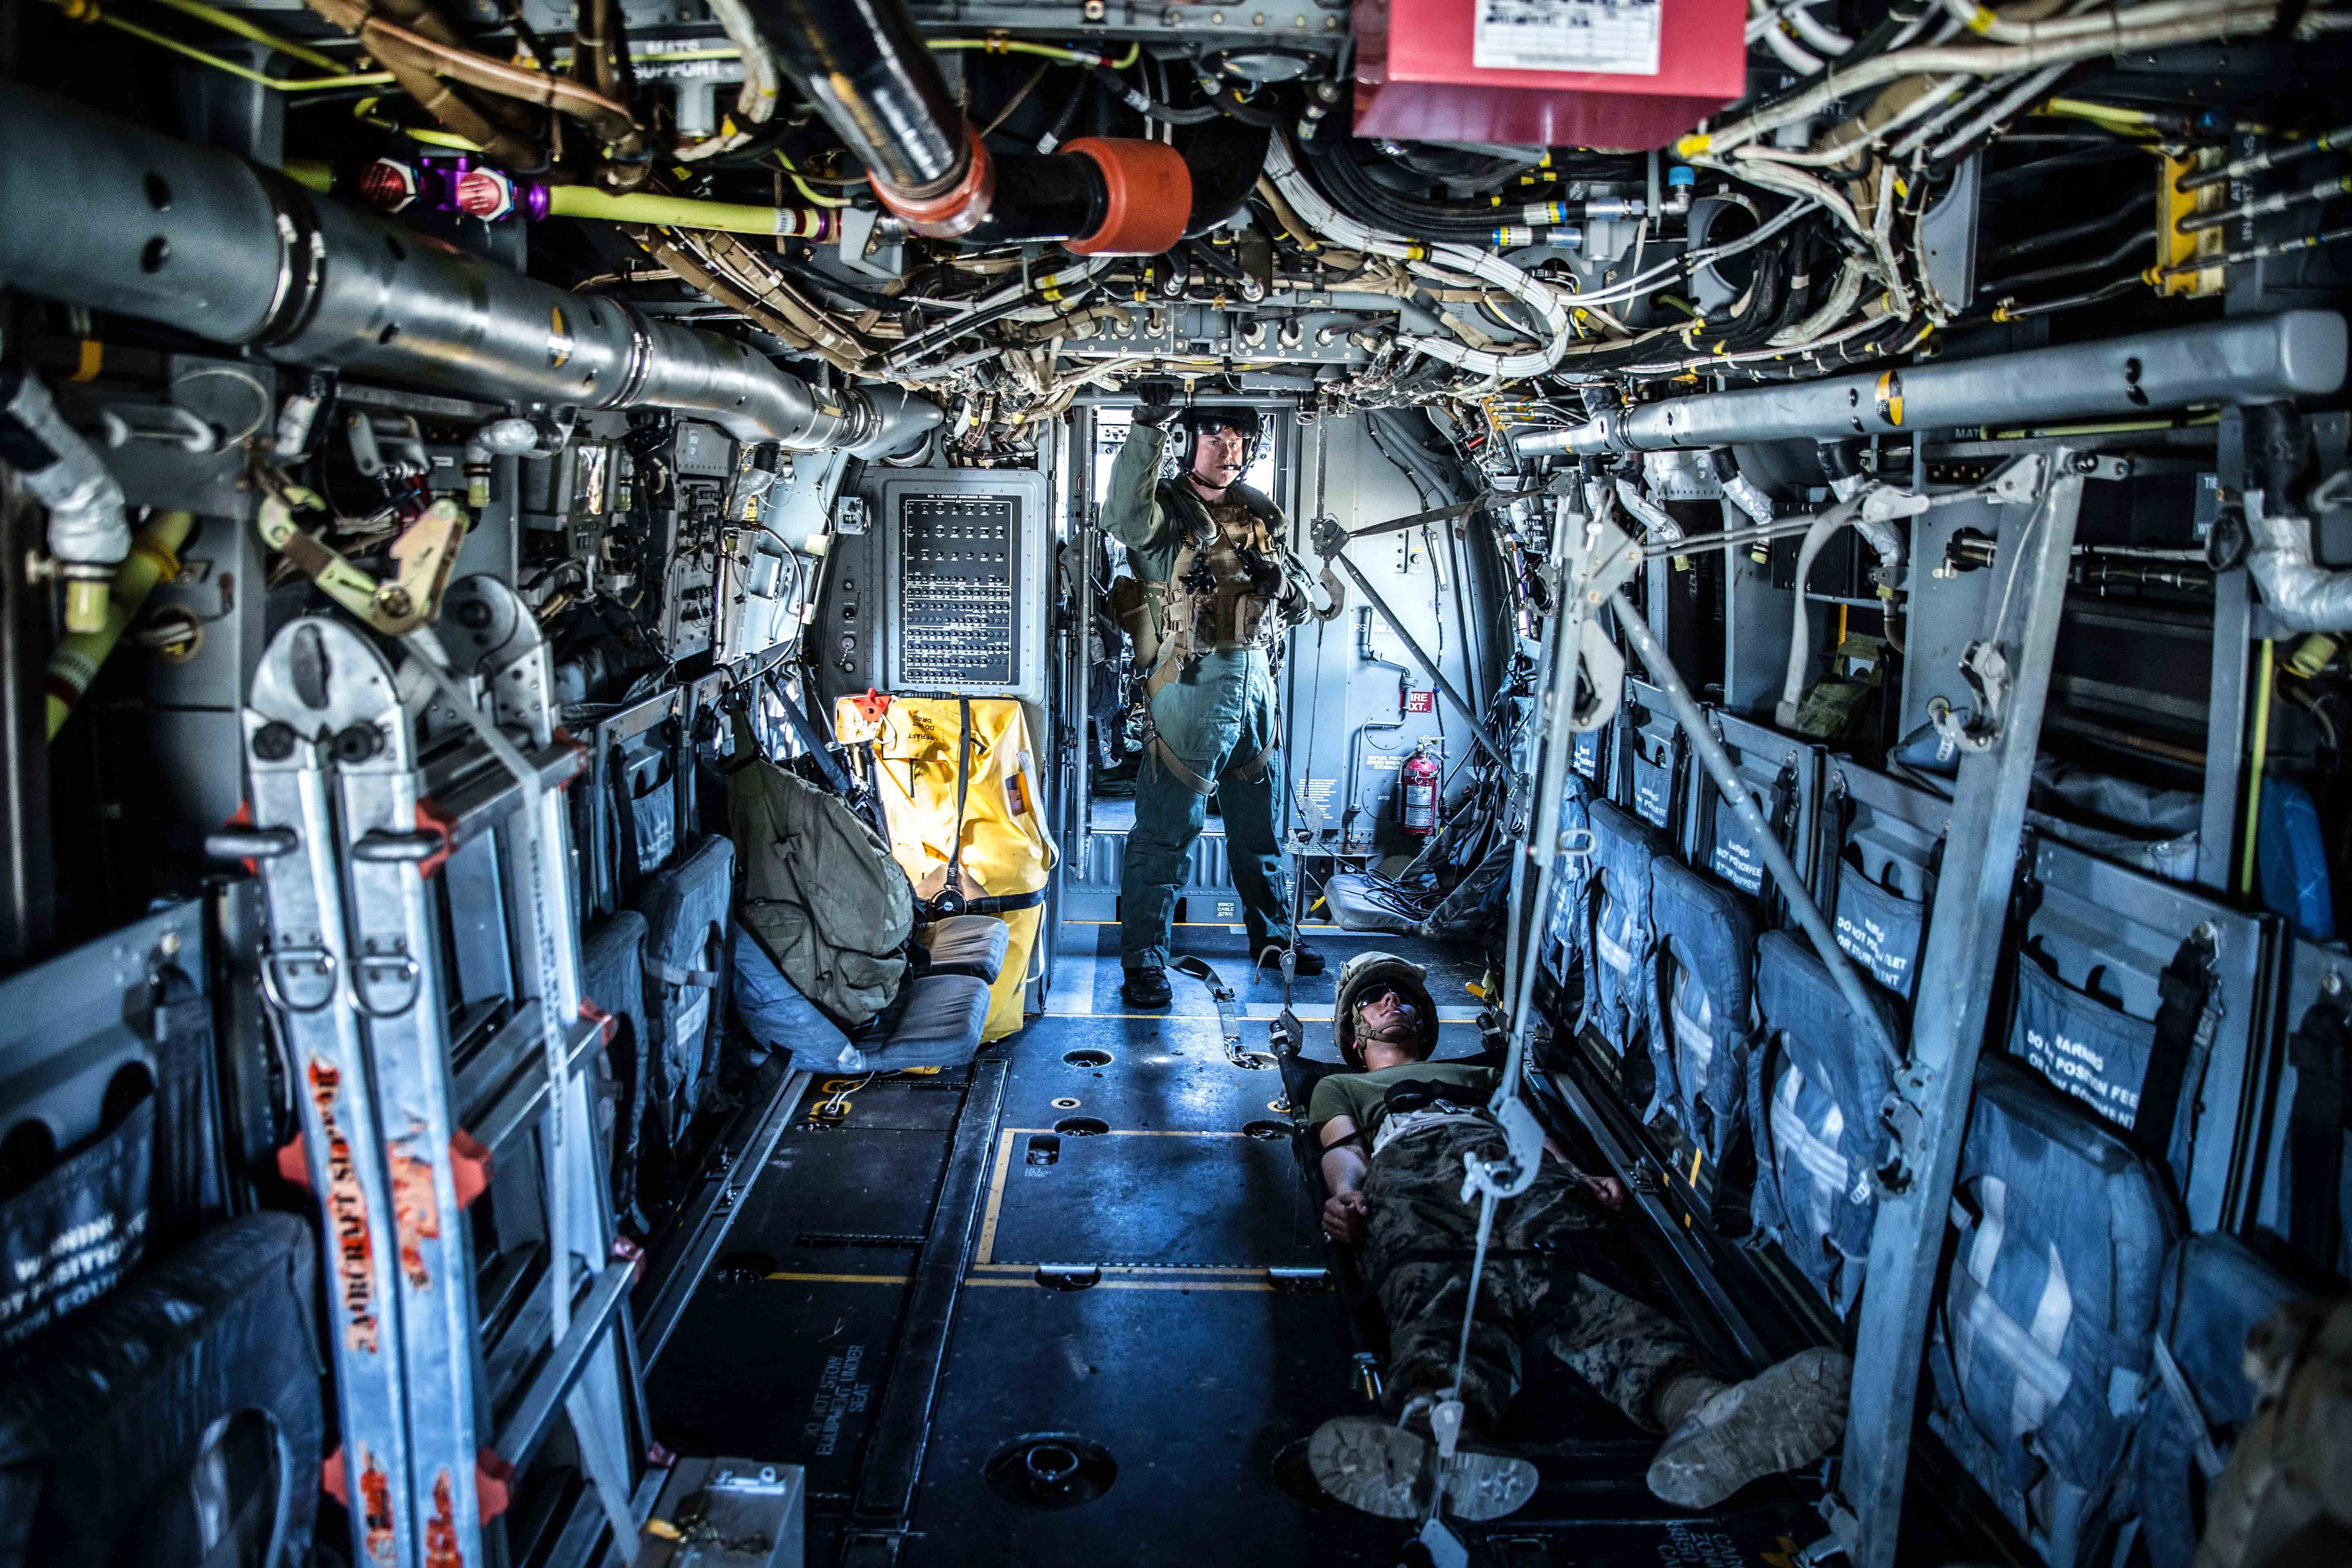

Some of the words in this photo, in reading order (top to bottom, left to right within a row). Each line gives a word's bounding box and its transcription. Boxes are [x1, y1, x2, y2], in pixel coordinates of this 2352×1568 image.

[1955, 428, 1980, 439] MAT
[1410, 693, 1428, 702] IRE
[1408, 702, 1427, 711] XT.
[913, 715, 932, 724] DRAG
[1837, 916, 1852, 932] DO
[2027, 1029, 2043, 1050] DO
[2111, 1085, 2138, 1109] FEE
[820, 1356, 843, 1388] STOW
[815, 1385, 851, 1455] EQUIPMENT
[840, 1345, 864, 1382] UNDER
[849, 1382, 870, 1412] SEAT
